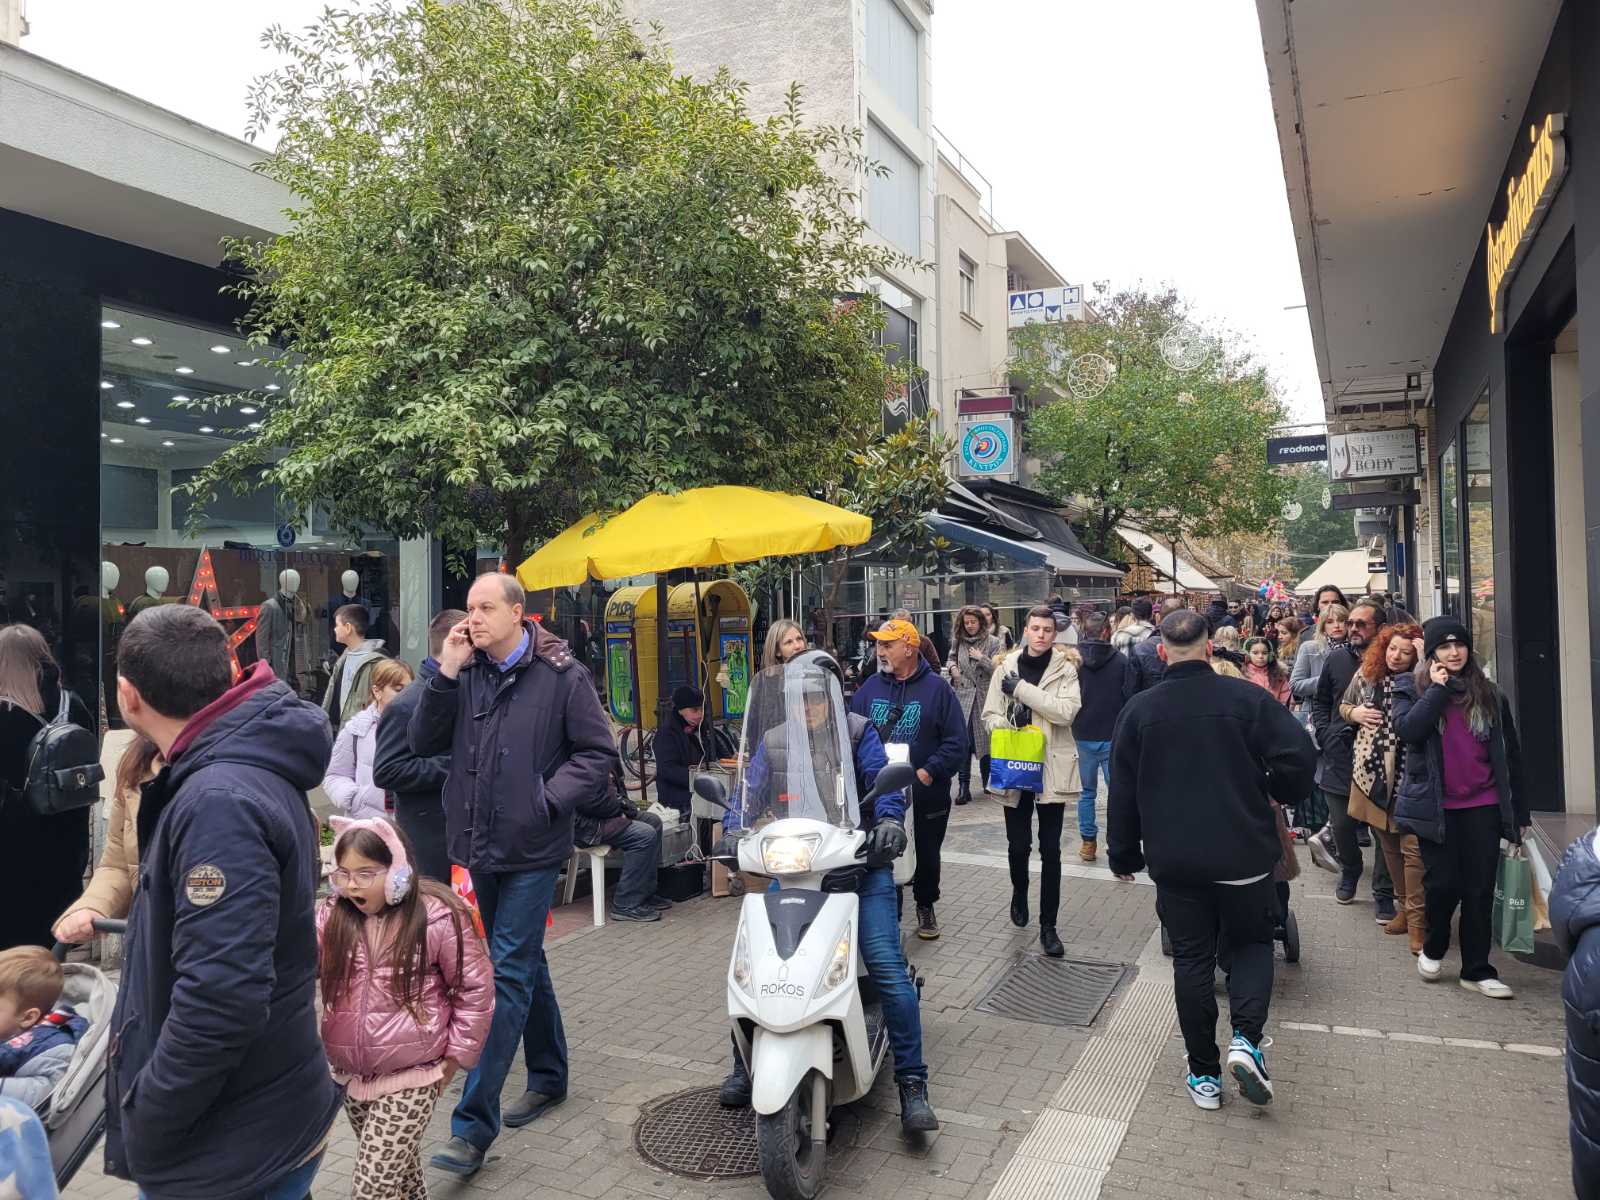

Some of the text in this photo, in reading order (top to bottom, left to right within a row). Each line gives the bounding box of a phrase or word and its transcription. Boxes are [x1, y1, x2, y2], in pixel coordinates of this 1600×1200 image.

[1279, 444, 1326, 455] readmore
[1355, 457, 1395, 473] BODY
[760, 983, 806, 997] ROKOS
